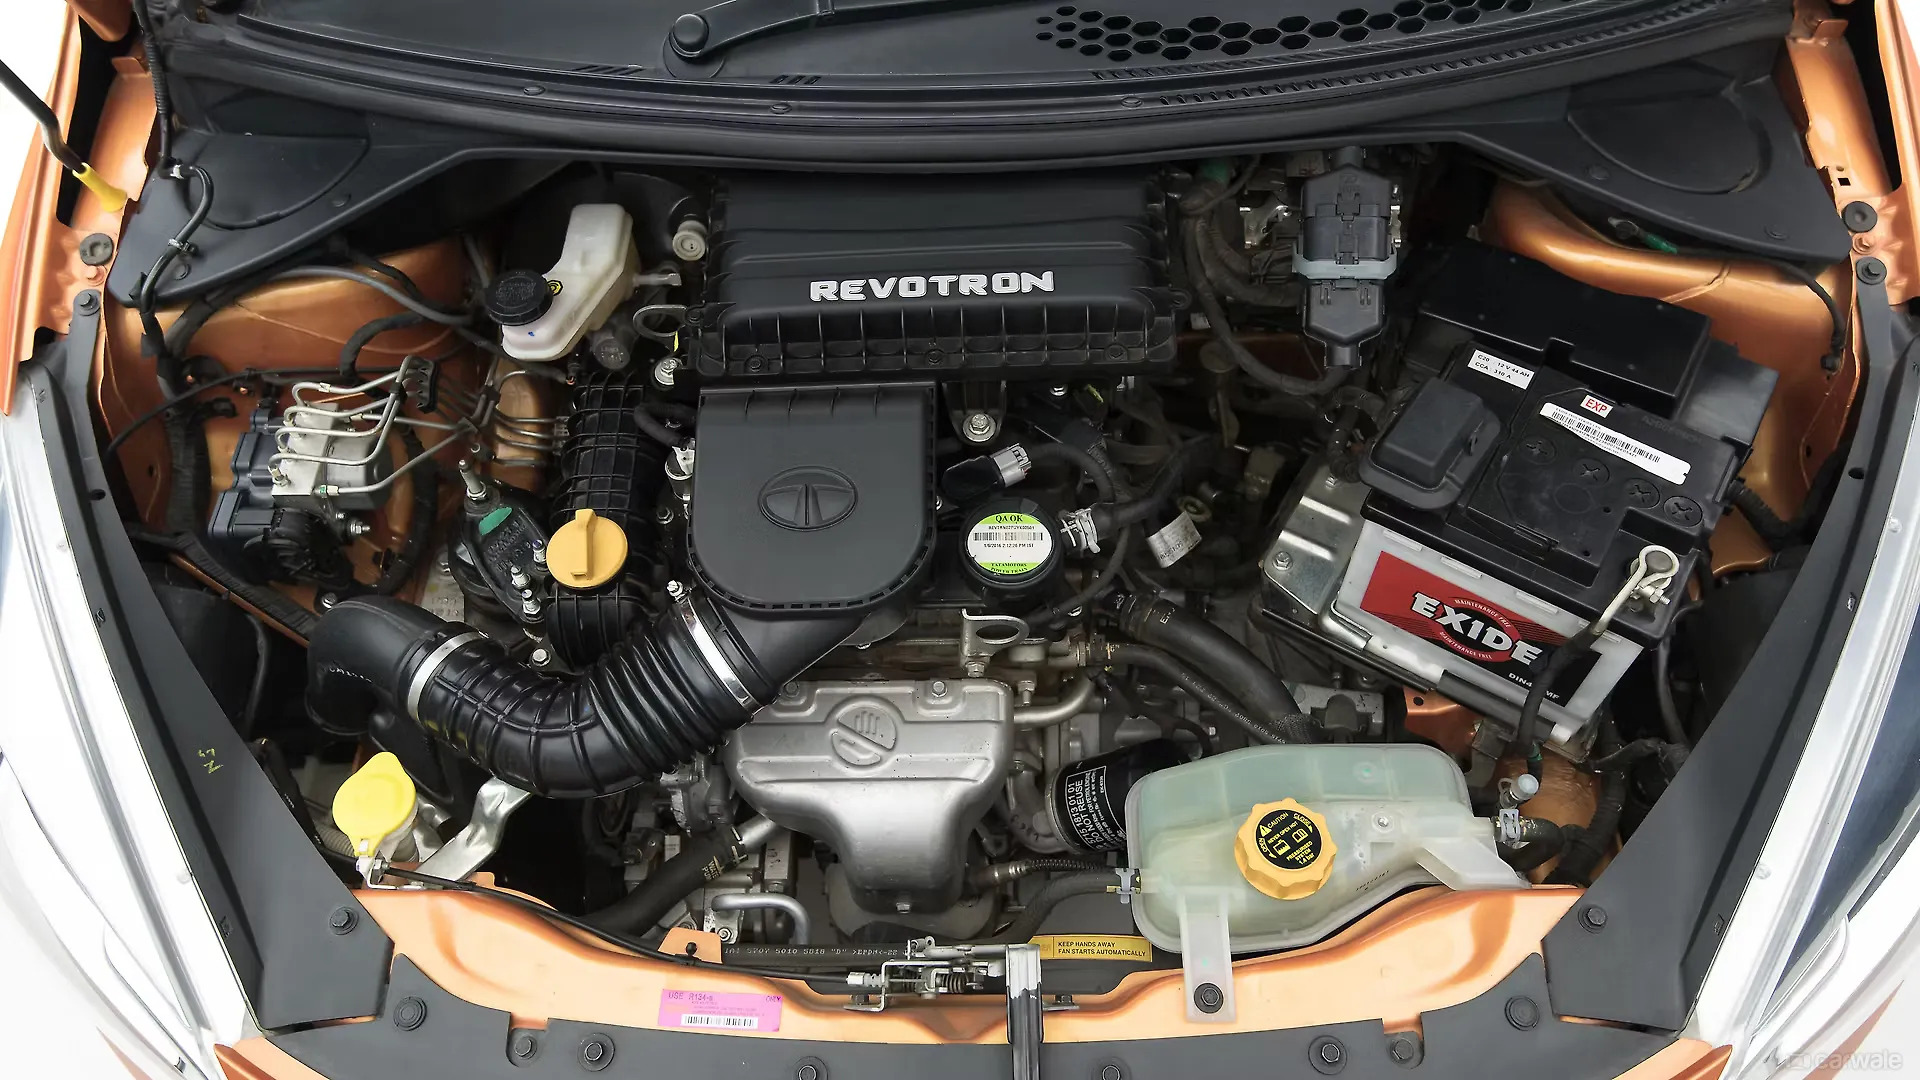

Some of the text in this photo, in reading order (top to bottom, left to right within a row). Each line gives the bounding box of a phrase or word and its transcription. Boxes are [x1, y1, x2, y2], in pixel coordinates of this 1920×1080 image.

[810, 270, 1055, 302] REVOTRON
[1475, 361, 1489, 370] CCA
[1585, 398, 1608, 413] EXP
[996, 514, 1023, 524] QA OK
[1454, 599, 1499, 617] MAINTENANCE
[1411, 591, 1543, 667] EXIDE
[1439, 631, 1477, 656] MAINTENANCE
[1508, 672, 1533, 687] DIN4
[1075, 779, 1088, 812] REUSE
[1067, 782, 1096, 845] 5715 1813 01 01
[1267, 812, 1289, 829] CAUTION
[1080, 813, 1095, 832] NOT
[1091, 832, 1104, 843] DO
[1096, 949, 1146, 957] AUTOMATICALLY
[668, 991, 683, 1000] USE
